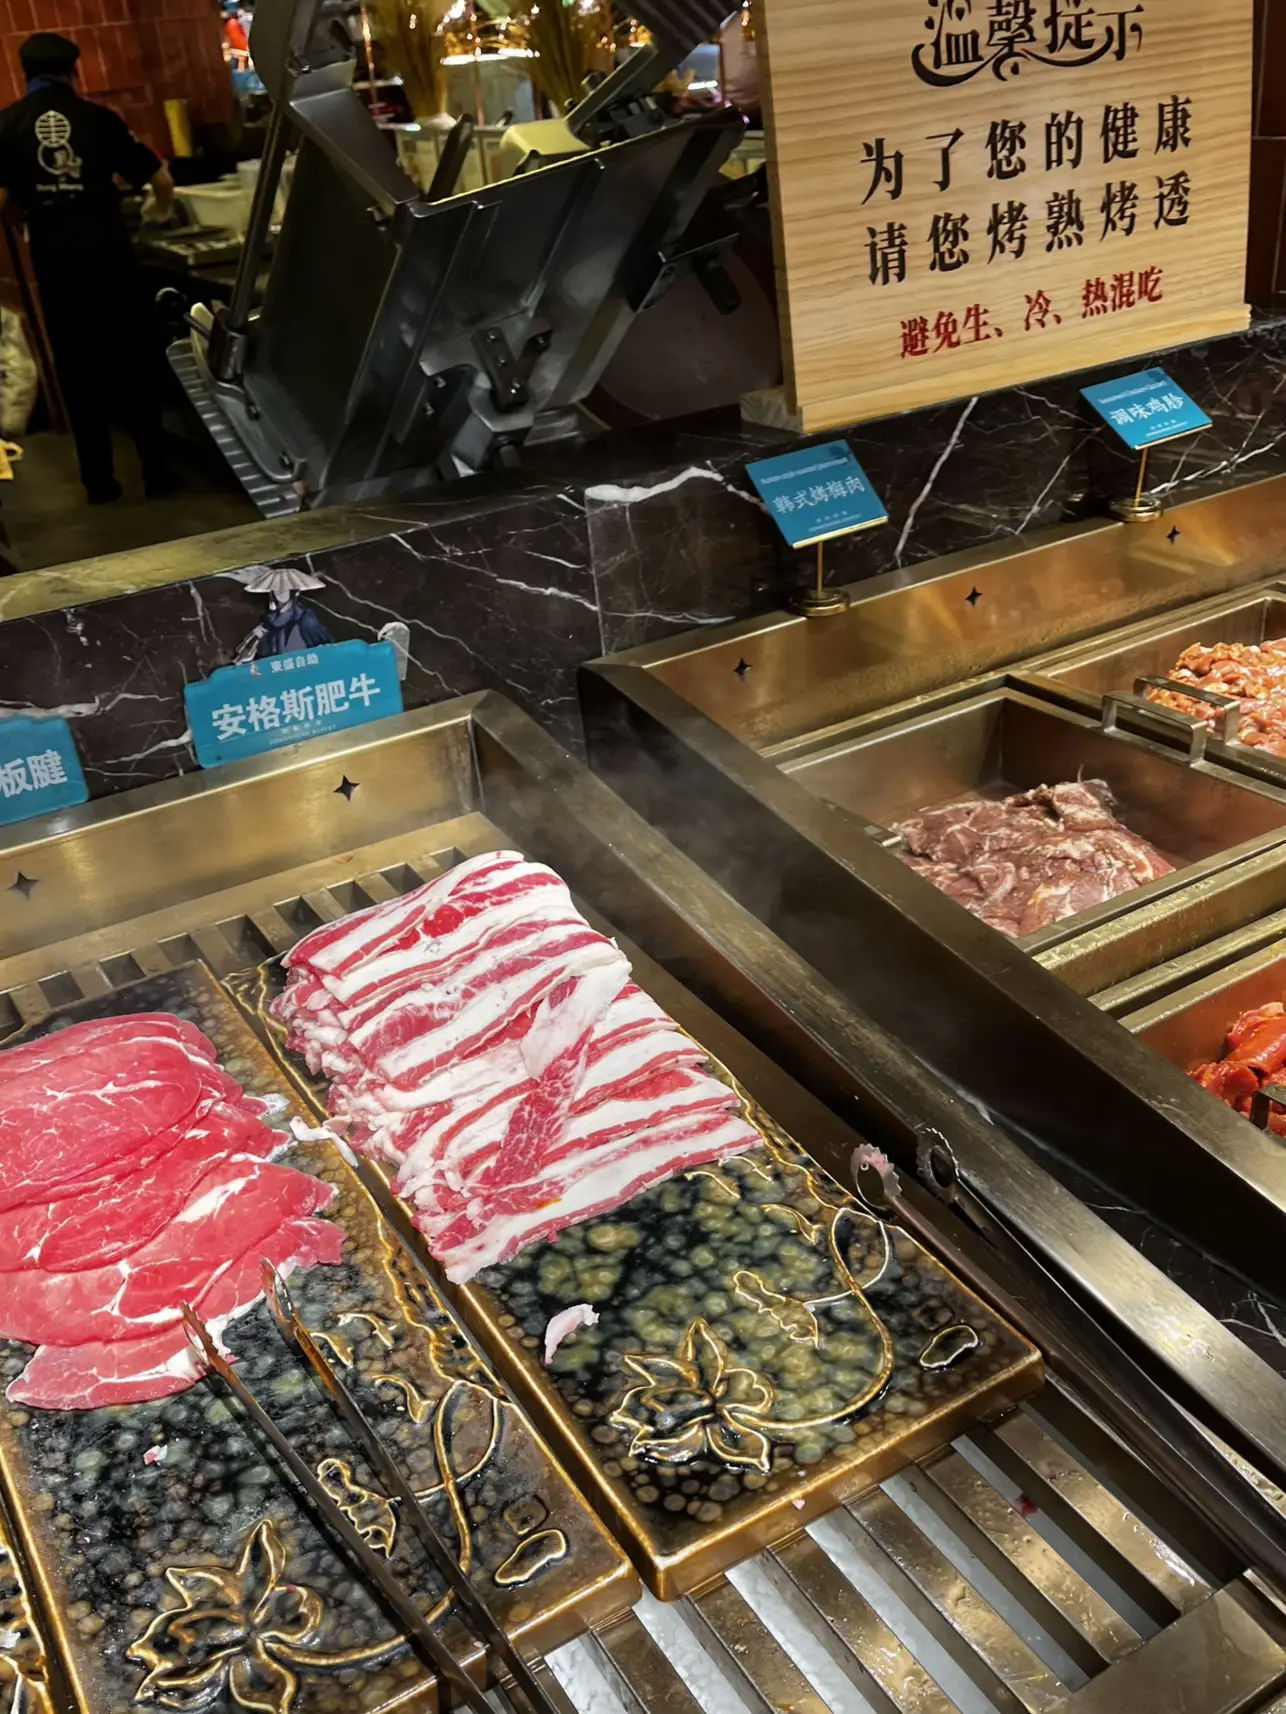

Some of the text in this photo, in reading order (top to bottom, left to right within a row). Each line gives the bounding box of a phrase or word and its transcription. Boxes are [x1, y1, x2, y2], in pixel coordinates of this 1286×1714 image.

[860, 94, 1193, 206] 为了您的健康
[863, 170, 1191, 287] 请您烤熟烤透
[900, 265, 1164, 359] 避免生、冷、热混吃
[211, 672, 381, 741] 安格斯肥牛
